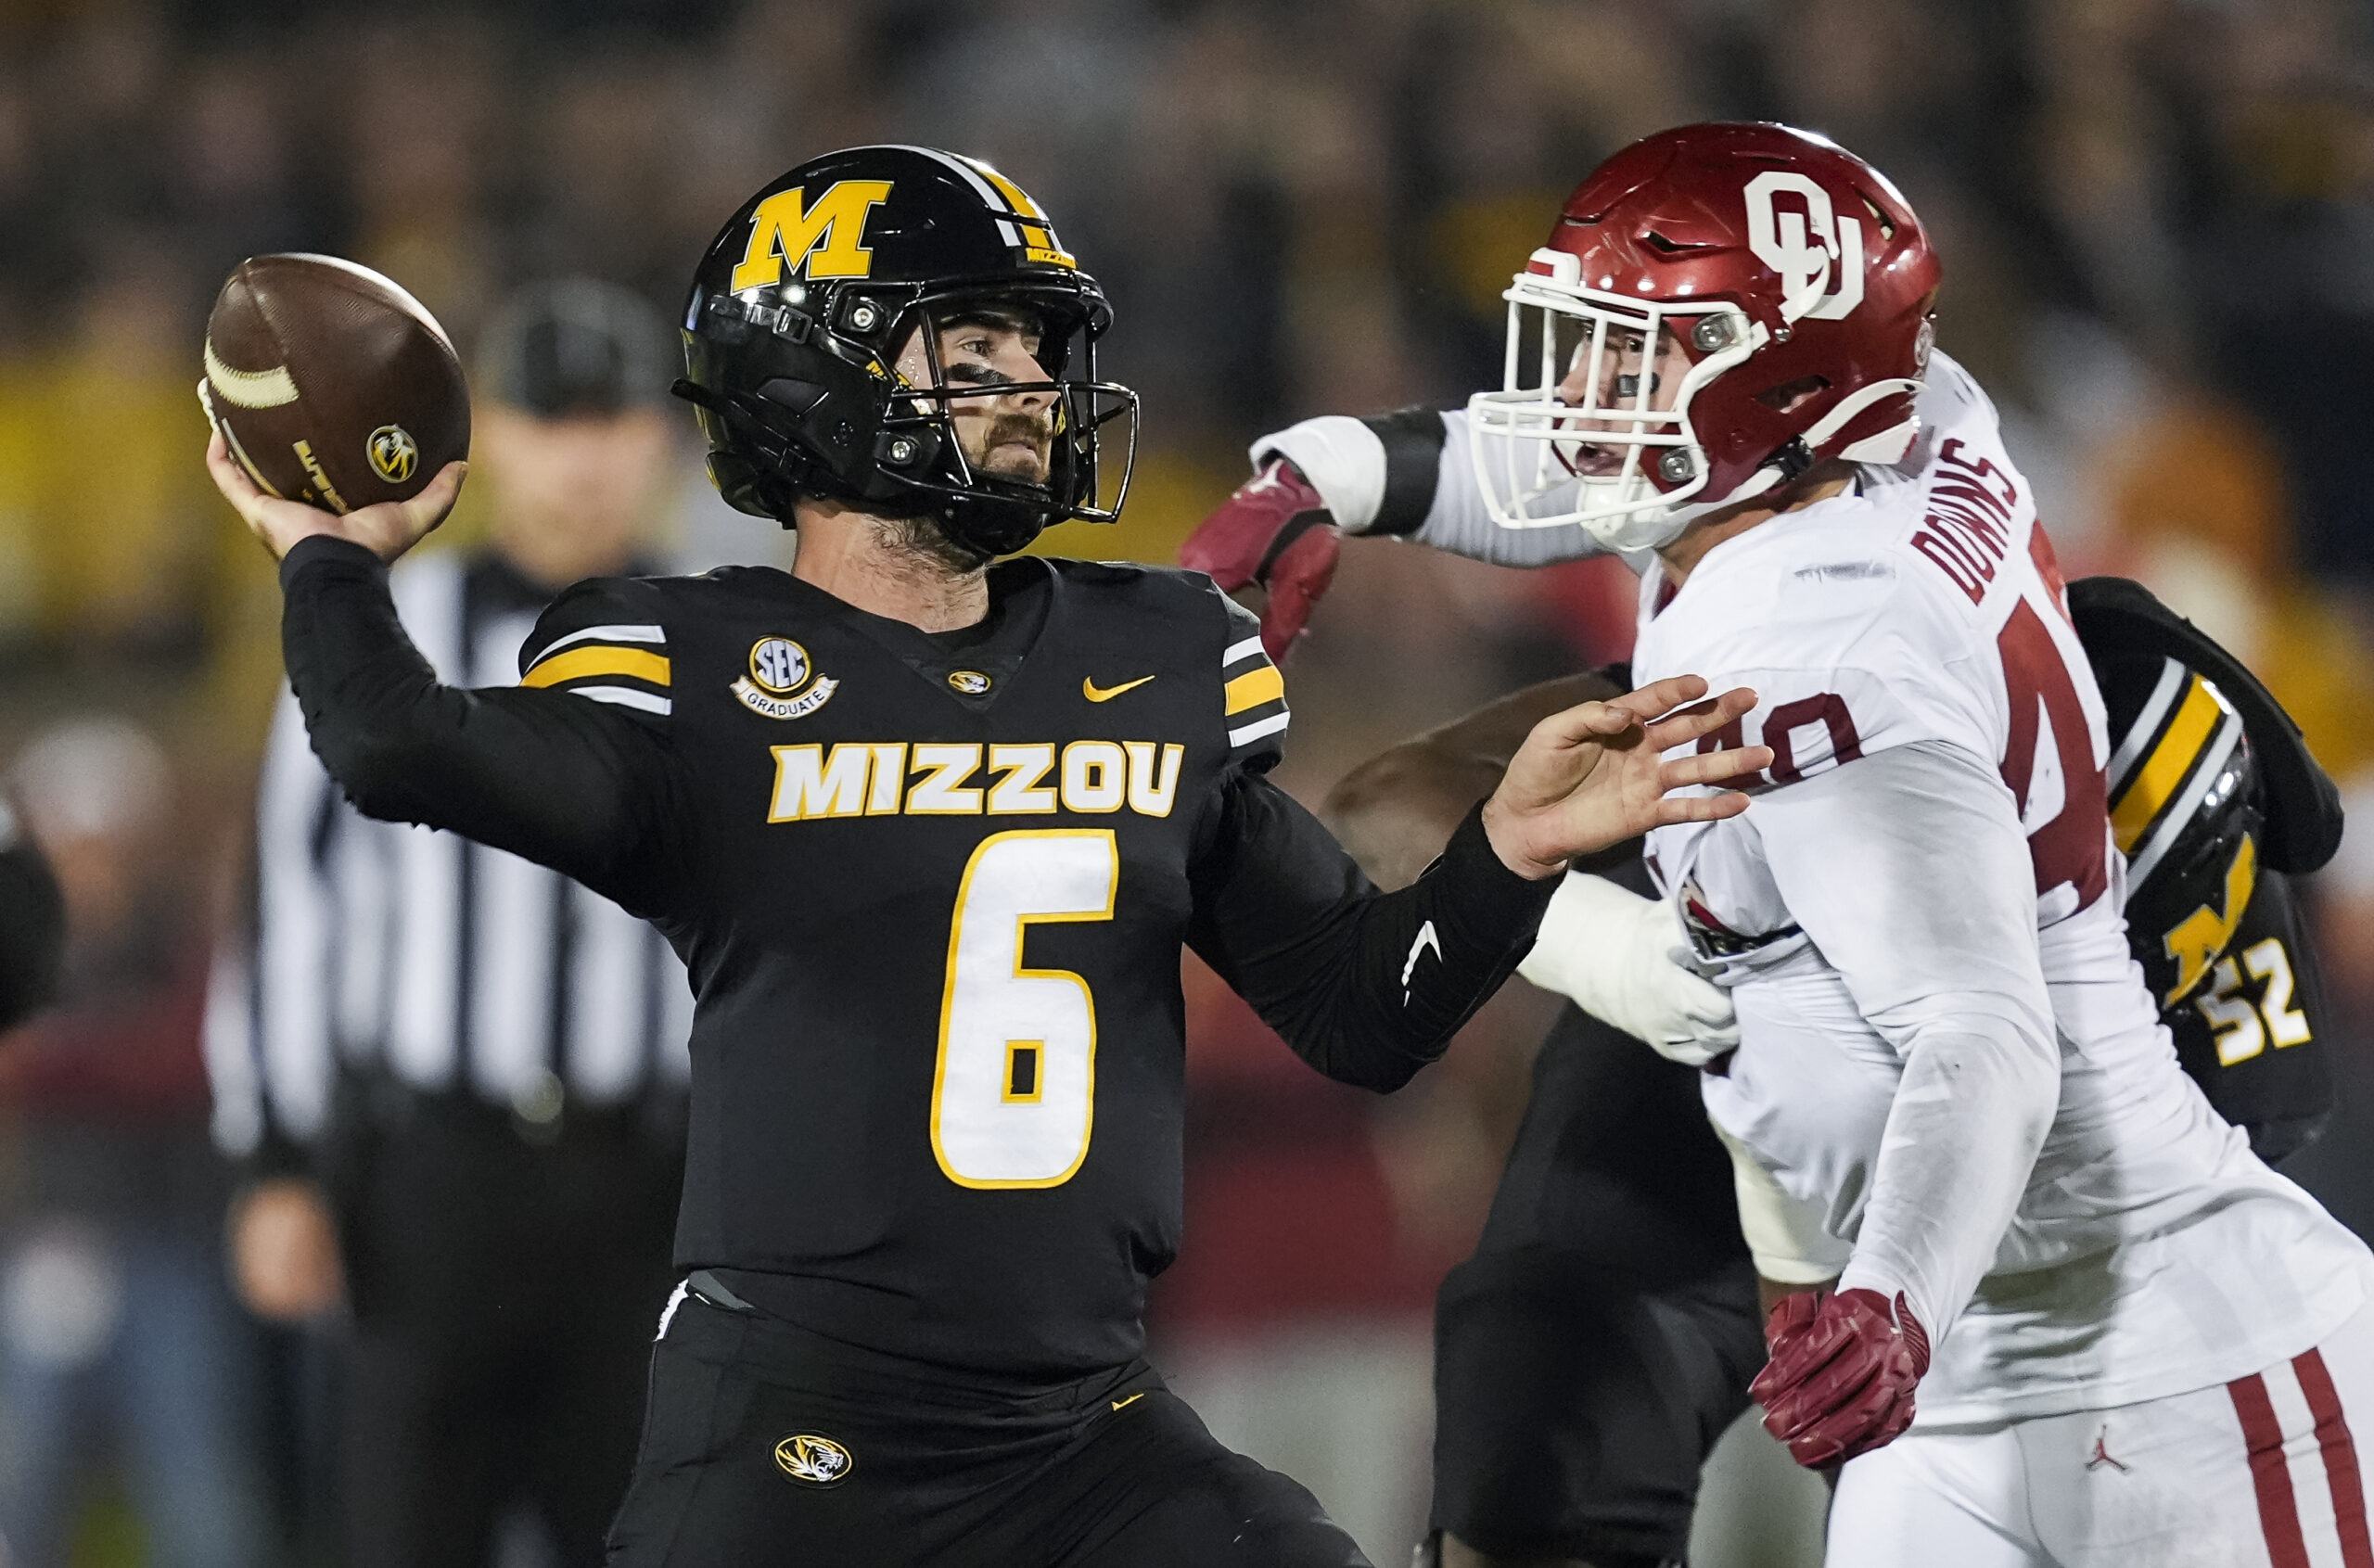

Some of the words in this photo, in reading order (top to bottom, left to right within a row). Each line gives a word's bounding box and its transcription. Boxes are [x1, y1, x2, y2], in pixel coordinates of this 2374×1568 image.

[730, 180, 895, 297] M
[1742, 171, 1865, 321] OU
[1910, 438, 2017, 606] DOWNS
[747, 690, 825, 717] GRADUATE
[755, 639, 807, 688] SEC
[1998, 518, 2109, 918] 4
[767, 741, 1185, 823] MIZZOU
[930, 828, 1119, 1190] 6
[2195, 937, 2313, 1067] 52
